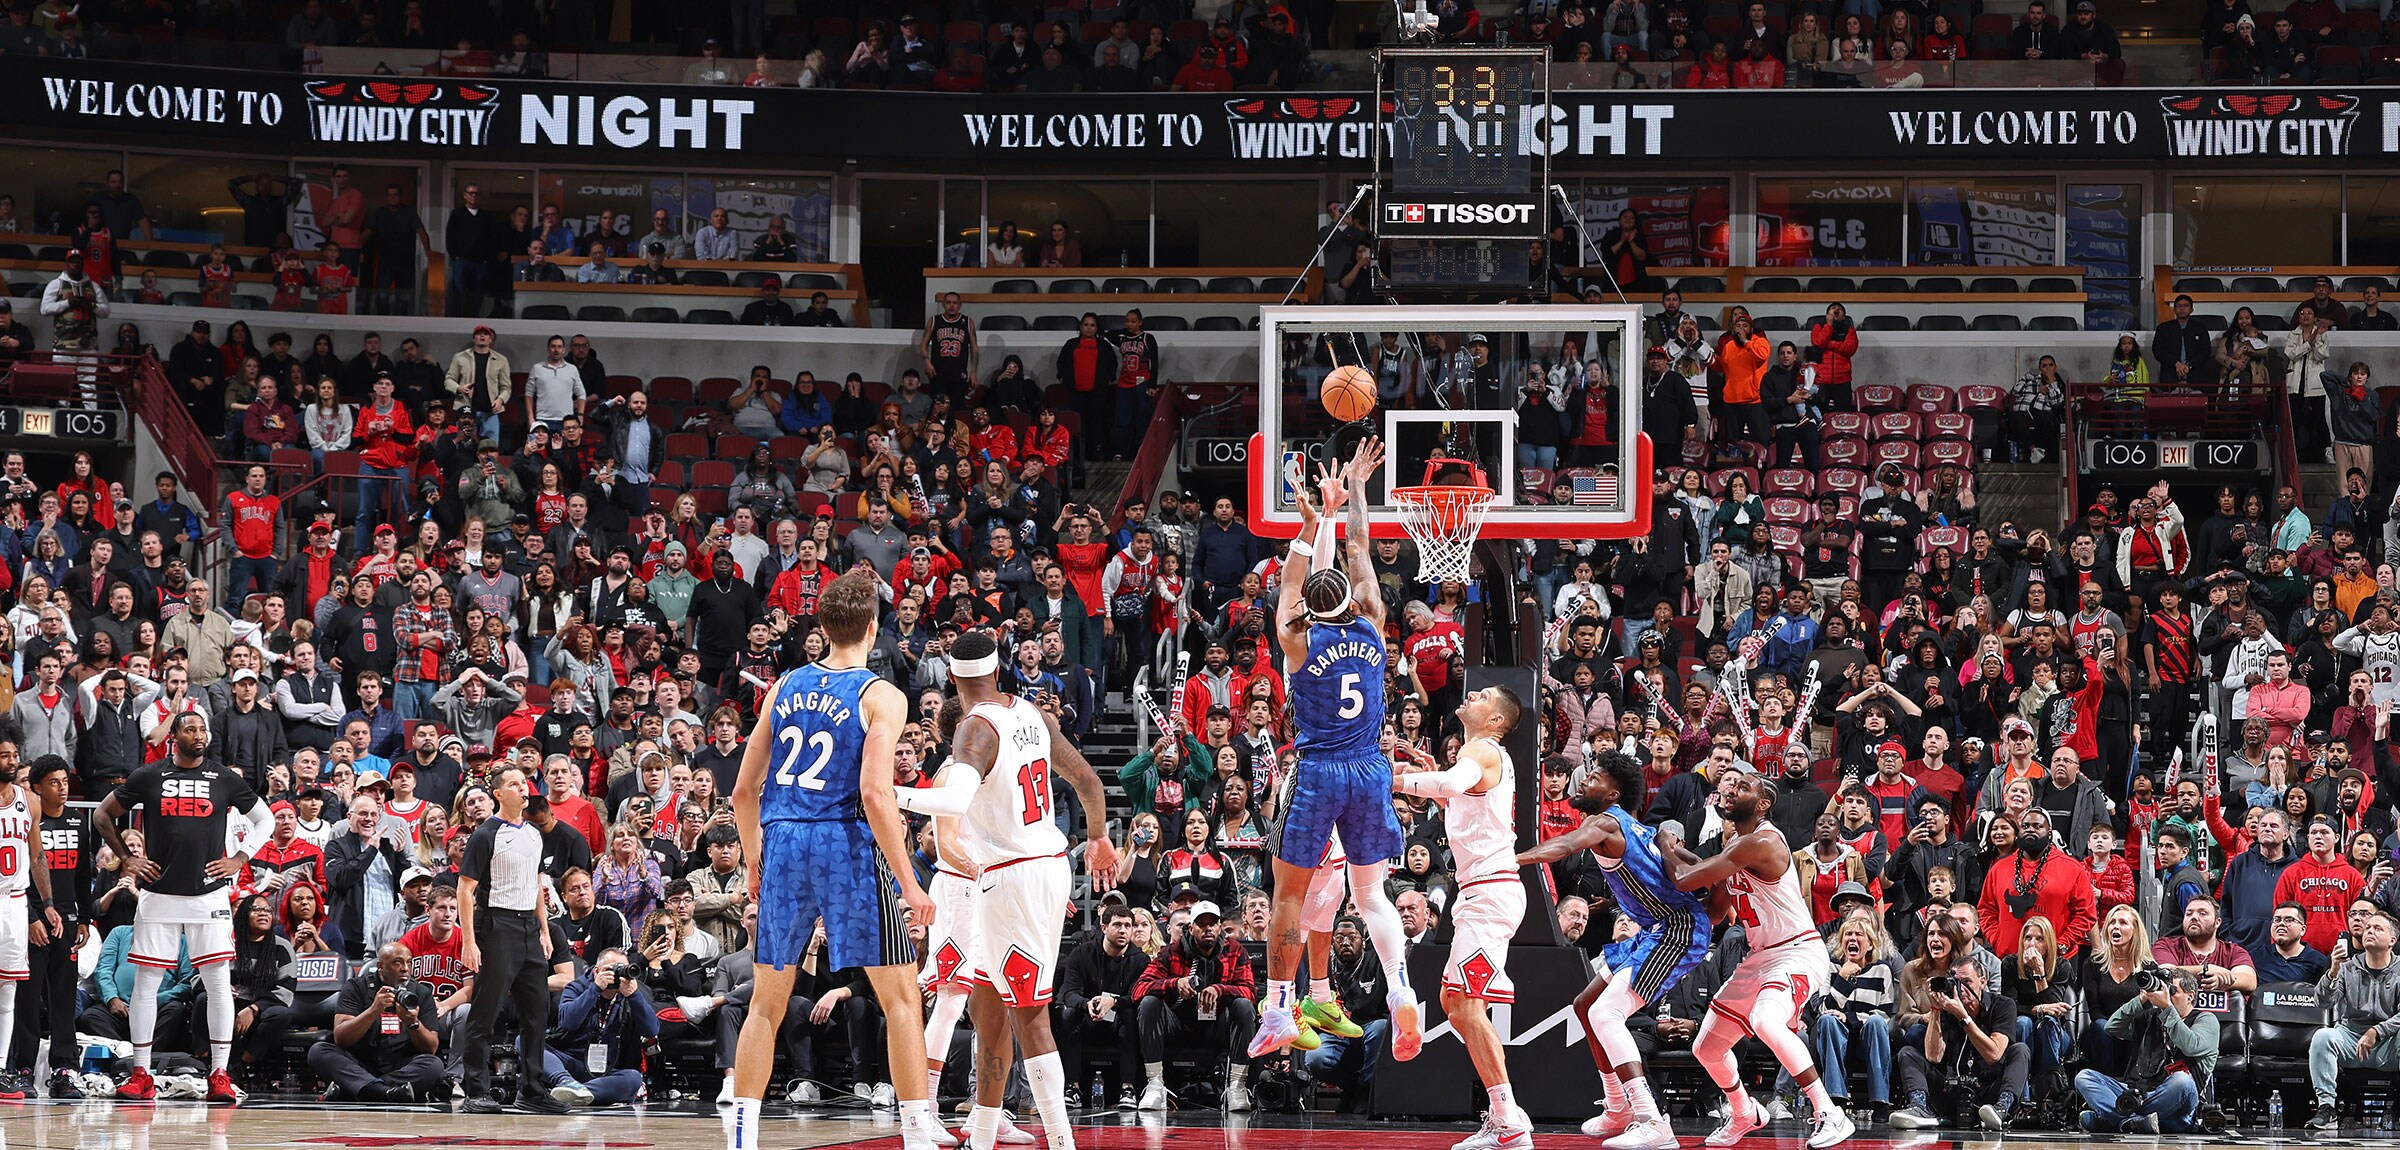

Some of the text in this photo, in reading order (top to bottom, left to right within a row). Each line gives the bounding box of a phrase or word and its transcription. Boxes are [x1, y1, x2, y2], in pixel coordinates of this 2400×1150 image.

[1432, 65, 1496, 107] 3.3
[1885, 76, 1906, 84] BULL
[42, 77, 755, 150] WELCOME TO WINDY CITY NIGHT
[963, 113, 1147, 148] WELCOME
[1157, 113, 1203, 147] TO
[1238, 121, 1334, 159] WINDY
[1888, 110, 2079, 145] WELCOME
[2090, 110, 2137, 145] TO
[2172, 118, 2274, 156] WINDY
[2278, 118, 2346, 156] CITY
[1427, 203, 1536, 224] TISSOT
[939, 340, 962, 357] 23
[25, 413, 51, 431] EXIT
[65, 413, 107, 435] 105
[1207, 442, 1247, 463] 105
[2104, 444, 2244, 465] 106 EXIT 107
[543, 508, 562, 524] 23
[362, 632, 378, 652] 8
[1412, 636, 1447, 656] BULLS
[1307, 641, 1383, 678] BANCHERO
[2367, 650, 2398, 666] CHICAGO
[1174, 658, 1188, 688] SEE
[2373, 666, 2392, 683] 12
[1141, 690, 1161, 718] SEE
[1338, 673, 1365, 720] 5
[775, 691, 852, 728] WAGNER
[1012, 726, 1041, 752] CRAIG
[2204, 724, 2216, 754] SEE
[775, 725, 835, 792] 22
[1765, 761, 1779, 778] 11
[161, 779, 210, 799] SEE
[1017, 757, 1051, 827] 13
[160, 798, 214, 818] RED
[41, 829, 79, 850] SEE
[47, 849, 79, 870] RED
[2299, 876, 2348, 891] CHICAGO
[302, 960, 329, 977] USO
[411, 955, 463, 982] BULLS
[2199, 992, 2217, 1008] SO
[2276, 993, 2316, 1002] LA RABIDA
